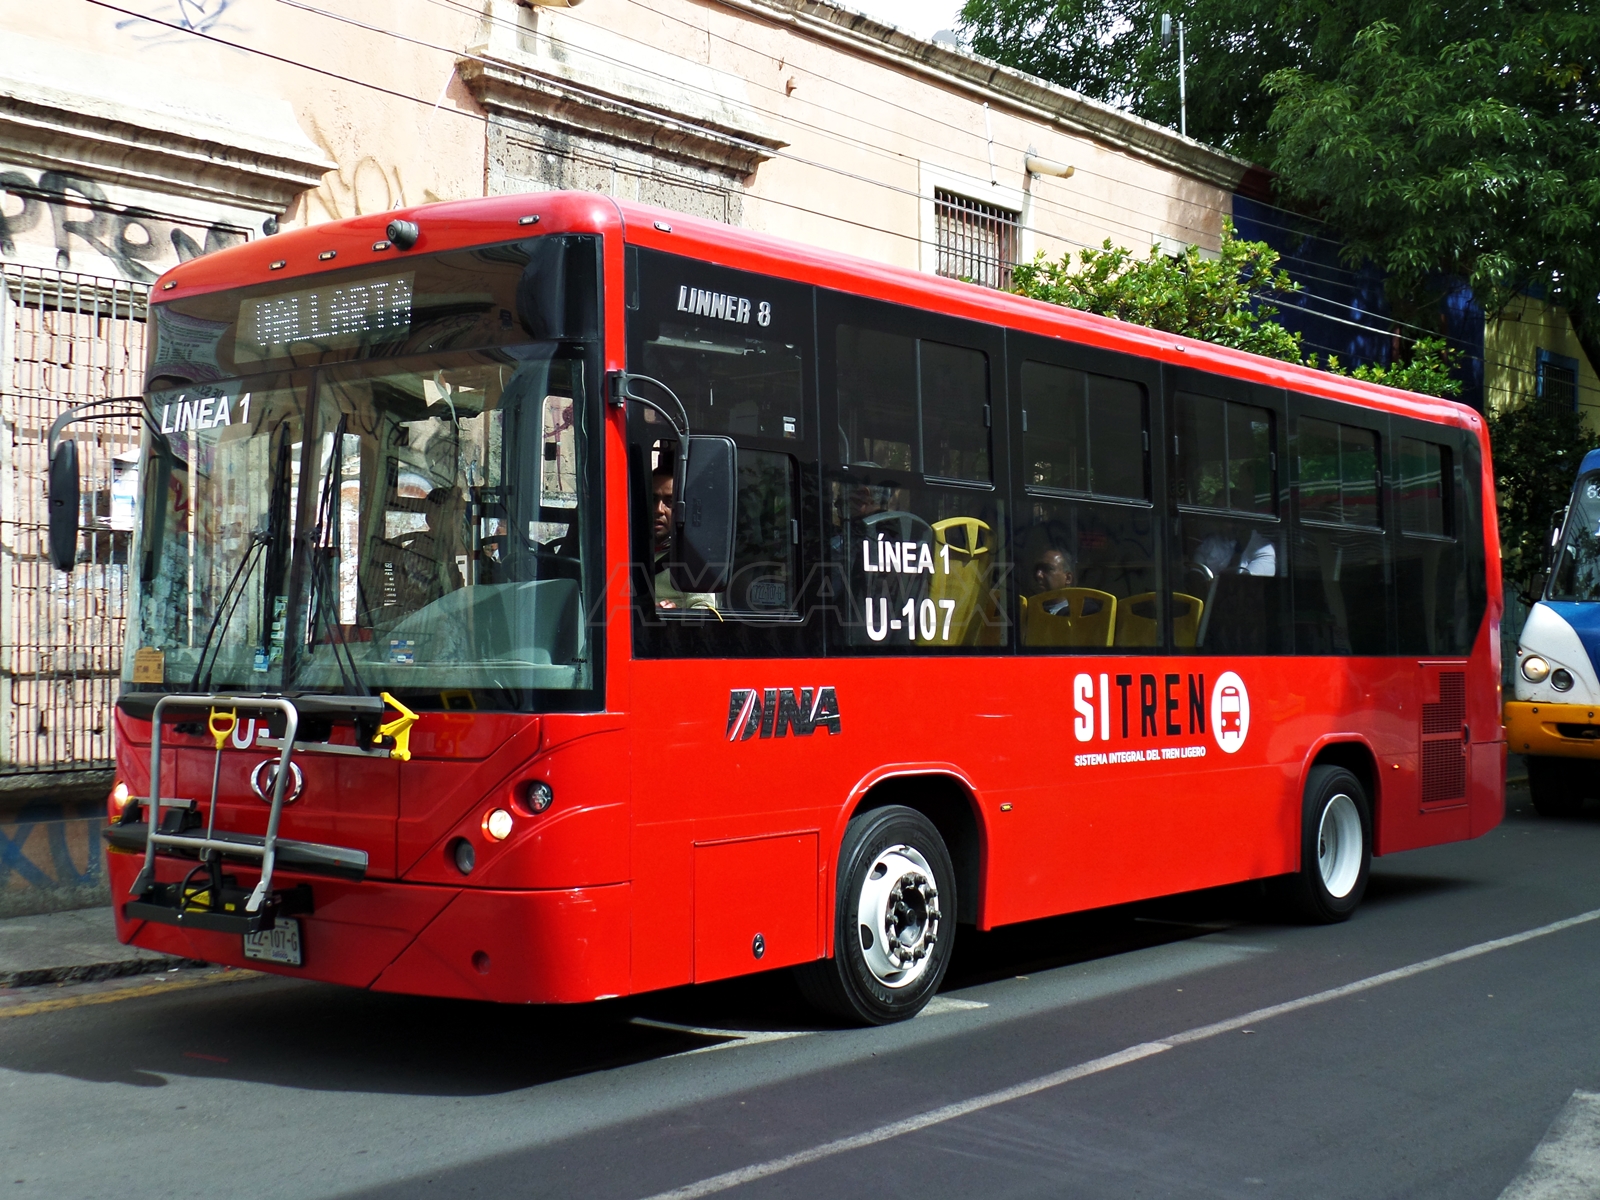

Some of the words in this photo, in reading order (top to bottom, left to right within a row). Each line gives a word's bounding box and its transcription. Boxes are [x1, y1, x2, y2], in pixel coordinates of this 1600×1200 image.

[677, 285, 752, 324] LINNER
[757, 301, 772, 327] 8
[161, 394, 231, 434] LÍNEA
[240, 392, 252, 424] 1
[863, 533, 935, 574] LÍNEA
[940, 544, 950, 575] 1
[865, 597, 956, 641] U-107
[725, 686, 842, 742] DINA
[1074, 753, 1108, 767] SISTEMA
[1109, 750, 1146, 764] INTEGRAL
[1146, 749, 1161, 761] DEL
[1161, 747, 1180, 760] TREN
[1181, 746, 1207, 758] LIGERO
